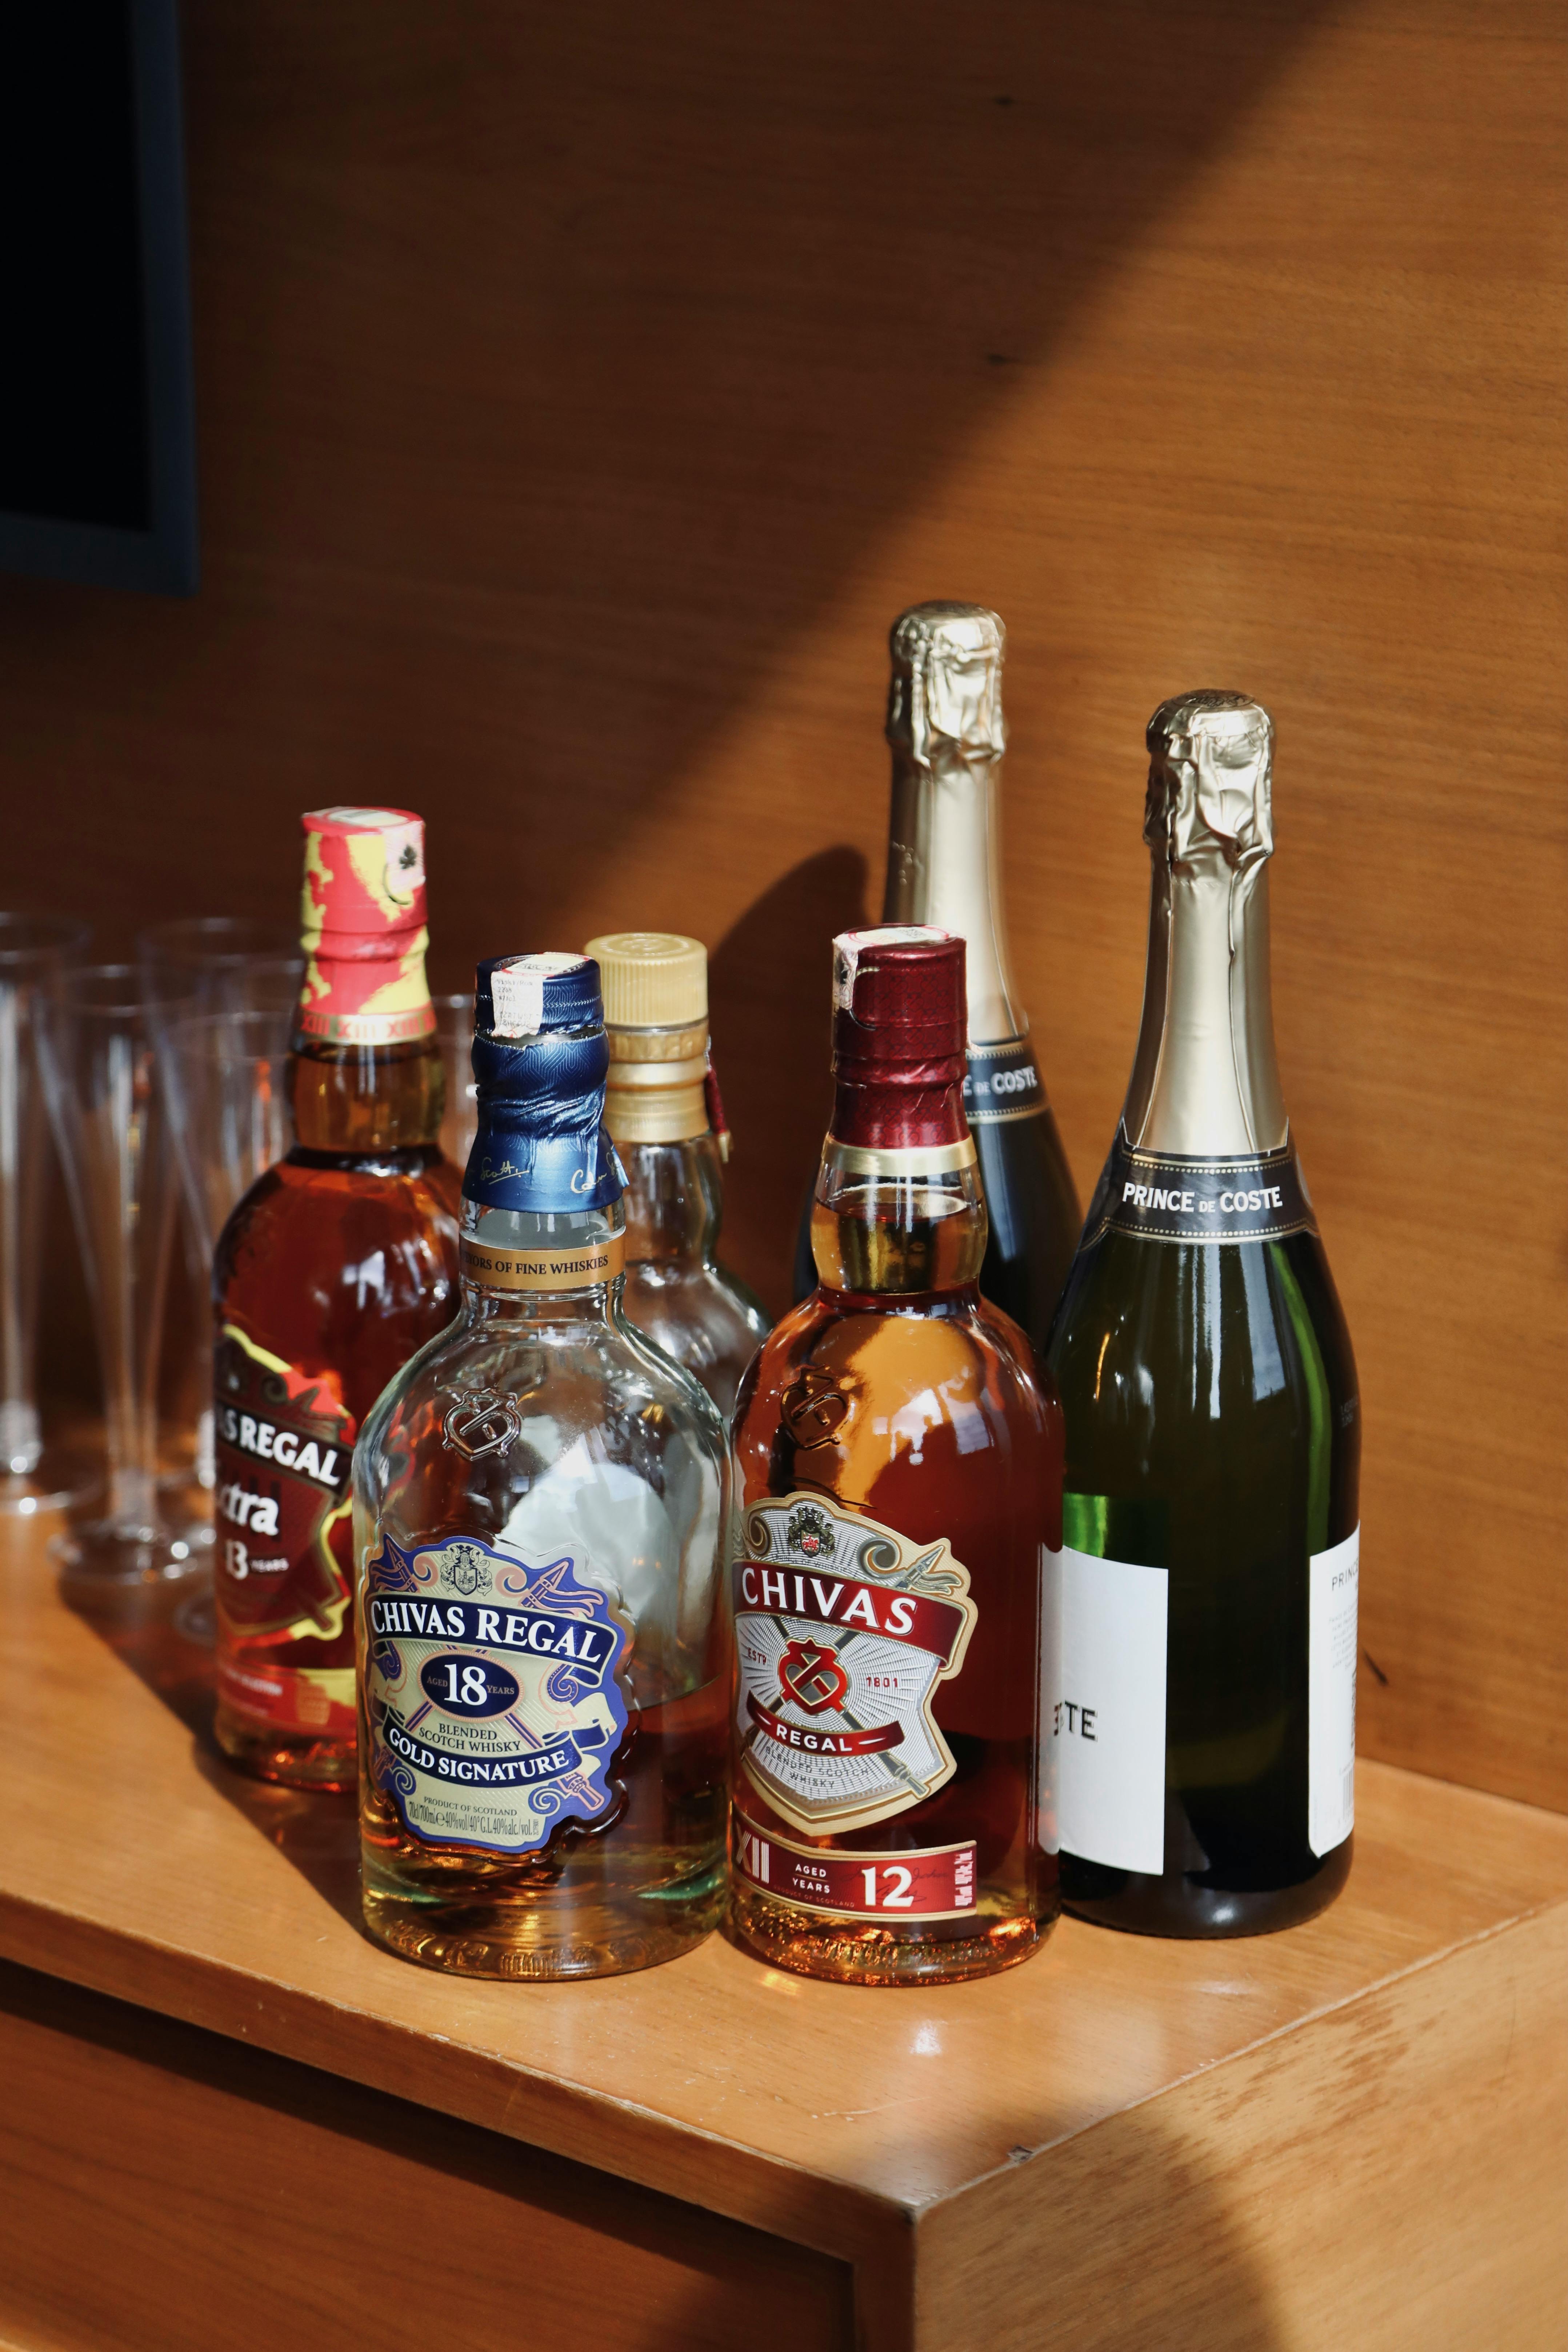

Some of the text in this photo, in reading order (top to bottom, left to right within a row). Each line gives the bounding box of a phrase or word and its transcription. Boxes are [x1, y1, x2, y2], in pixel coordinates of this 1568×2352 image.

[387, 1018, 420, 1038] XIII
[990, 1065, 1037, 1095] COSTE
[1122, 1182, 1283, 1213] PRINCE DE COSTE
[495, 1260, 512, 1272] OF
[515, 1263, 546, 1275] FINE
[549, 1255, 608, 1274] WHISKIES
[239, 1414, 340, 1487] REGAL
[742, 1567, 917, 1635] CHIVAS
[371, 1600, 601, 1664] CHIVAS REGAL
[427, 1664, 515, 1705] AGED 18 YEARS
[866, 1676, 899, 1688] 1801
[419, 1727, 521, 1752] SCOTCH WHISKY
[439, 1723, 497, 1740] BLENDED
[776, 1723, 852, 1752] REGAL
[389, 1728, 569, 1781] GOLD SIGNATURE
[766, 1747, 869, 1777] BLENDED SCOTCH
[790, 1771, 835, 1789] WHISKY
[424, 1796, 459, 1809] PRODUCT
[473, 1806, 517, 1816] SCOTLAND
[795, 1864, 827, 1877] AGED
[792, 1878, 830, 1894] YEARS
[861, 1866, 914, 1907] 12
[816, 1897, 855, 1908] SCOTLAND
